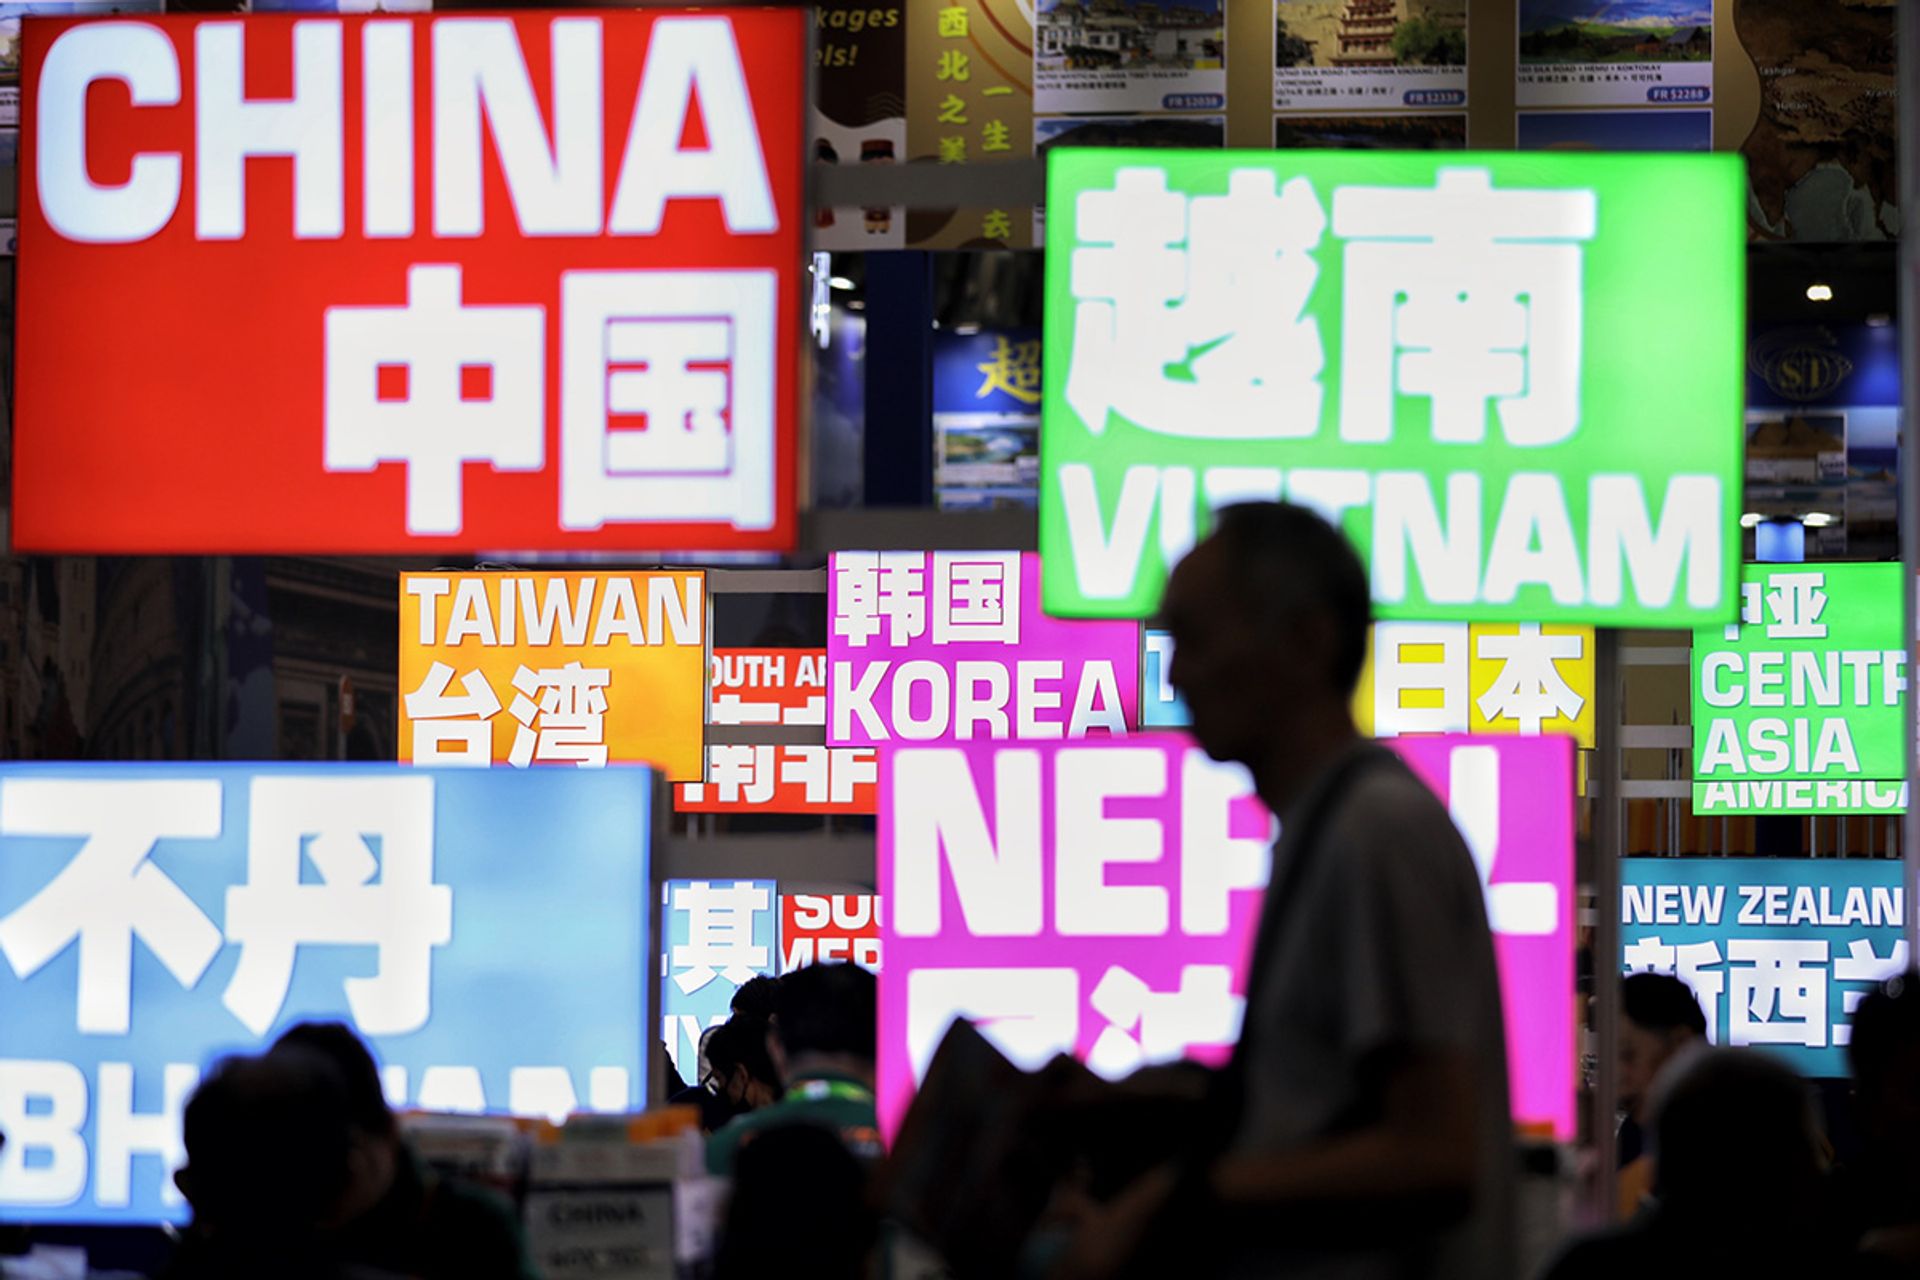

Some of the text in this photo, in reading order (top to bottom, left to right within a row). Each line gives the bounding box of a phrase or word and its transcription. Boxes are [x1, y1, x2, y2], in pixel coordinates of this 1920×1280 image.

[816, 6, 899, 32] kages
[36, 17, 780, 244] CHINA
[982, 86, 1014, 239] 一生去
[1065, 165, 1598, 447] 越南
[323, 263, 779, 536] 中国
[1058, 464, 1723, 609] VINAM
[406, 577, 702, 647] TAIWAN
[834, 551, 1021, 647] 韩国
[404, 661, 612, 769] 台湾
[833, 659, 1129, 740] KOREA
[1374, 621, 1586, 737] 日本
[1699, 717, 1861, 774] ASIA
[893, 746, 1559, 937] NEPL
[0, 775, 453, 1035] 不丹
[662, 881, 769, 996] 其
[1622, 885, 1904, 926] NEW ZEALAN
